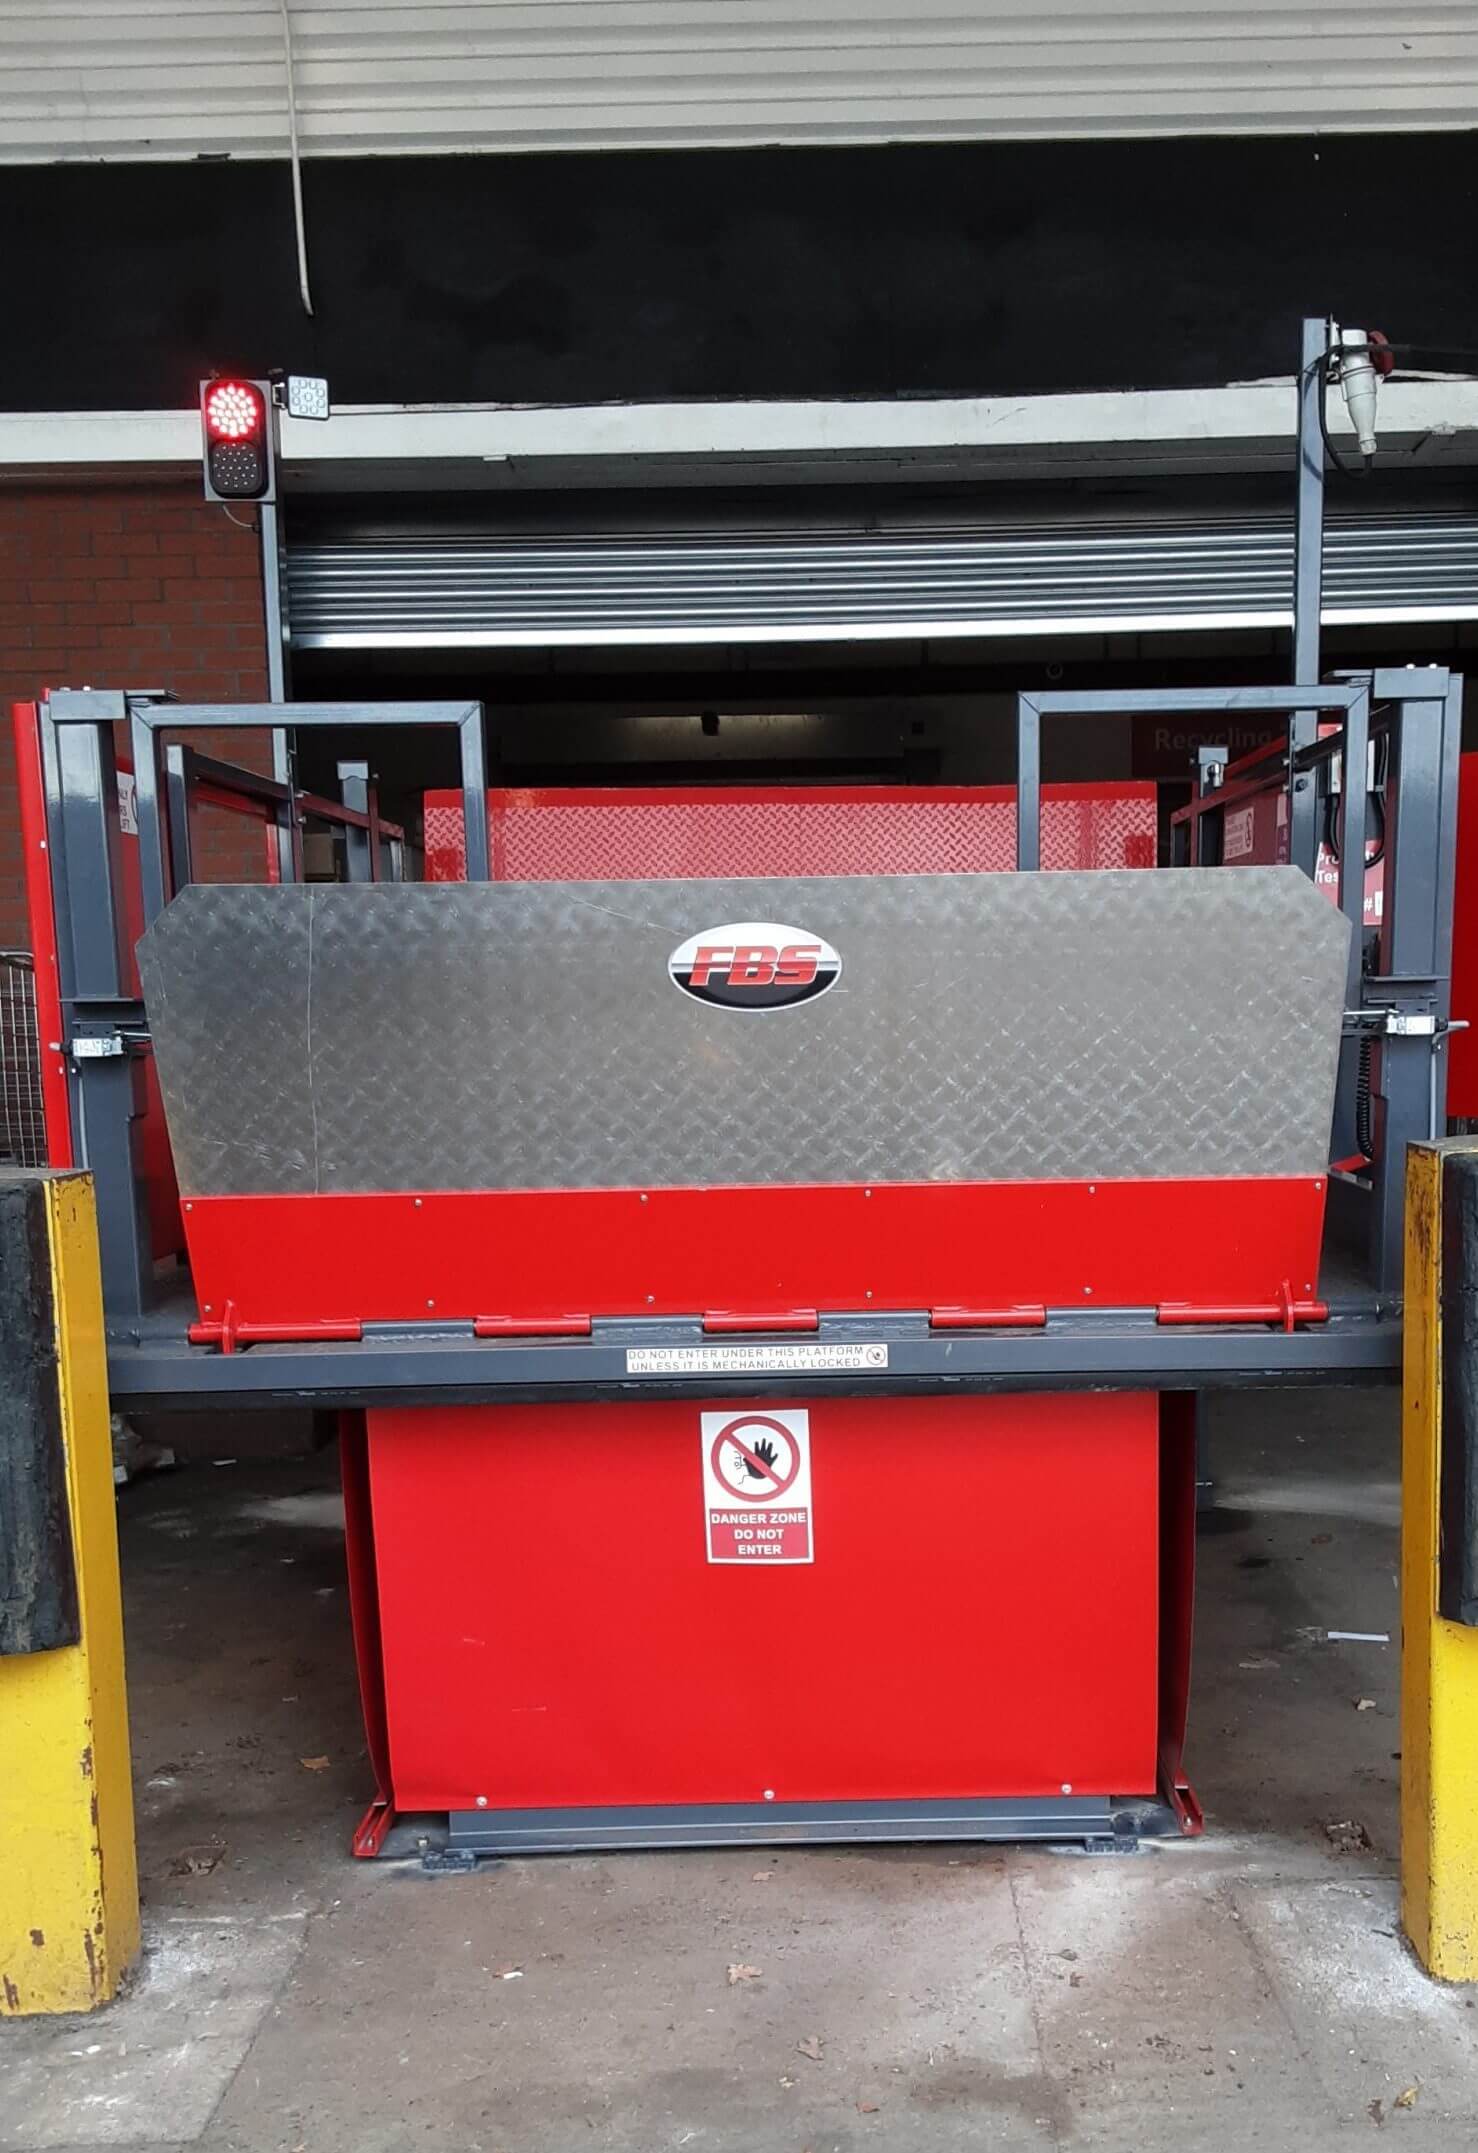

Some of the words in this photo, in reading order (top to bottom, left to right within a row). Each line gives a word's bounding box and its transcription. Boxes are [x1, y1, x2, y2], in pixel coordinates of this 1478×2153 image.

[1154, 727, 1272, 751] Recycling
[689, 944, 822, 986] FBS
[628, 1350, 646, 1360] DO
[649, 1350, 674, 1360] NOT
[678, 1349, 718, 1359] ENTER
[721, 1348, 763, 1358] UNDER
[767, 1347, 794, 1357] THIS
[798, 1346, 864, 1356] PLATFORM
[631, 1361, 680, 1371] UNLESS
[683, 1361, 693, 1370] IT
[697, 1360, 709, 1370] IS
[712, 1359, 807, 1370] MECHANICALLY
[810, 1358, 861, 1368] LOCKED
[711, 1513, 768, 1524] DANGER
[769, 1512, 807, 1523] ZONE
[733, 1529, 754, 1540] DO
[756, 1528, 784, 1540] NOT
[737, 1544, 783, 1555] ENTER
